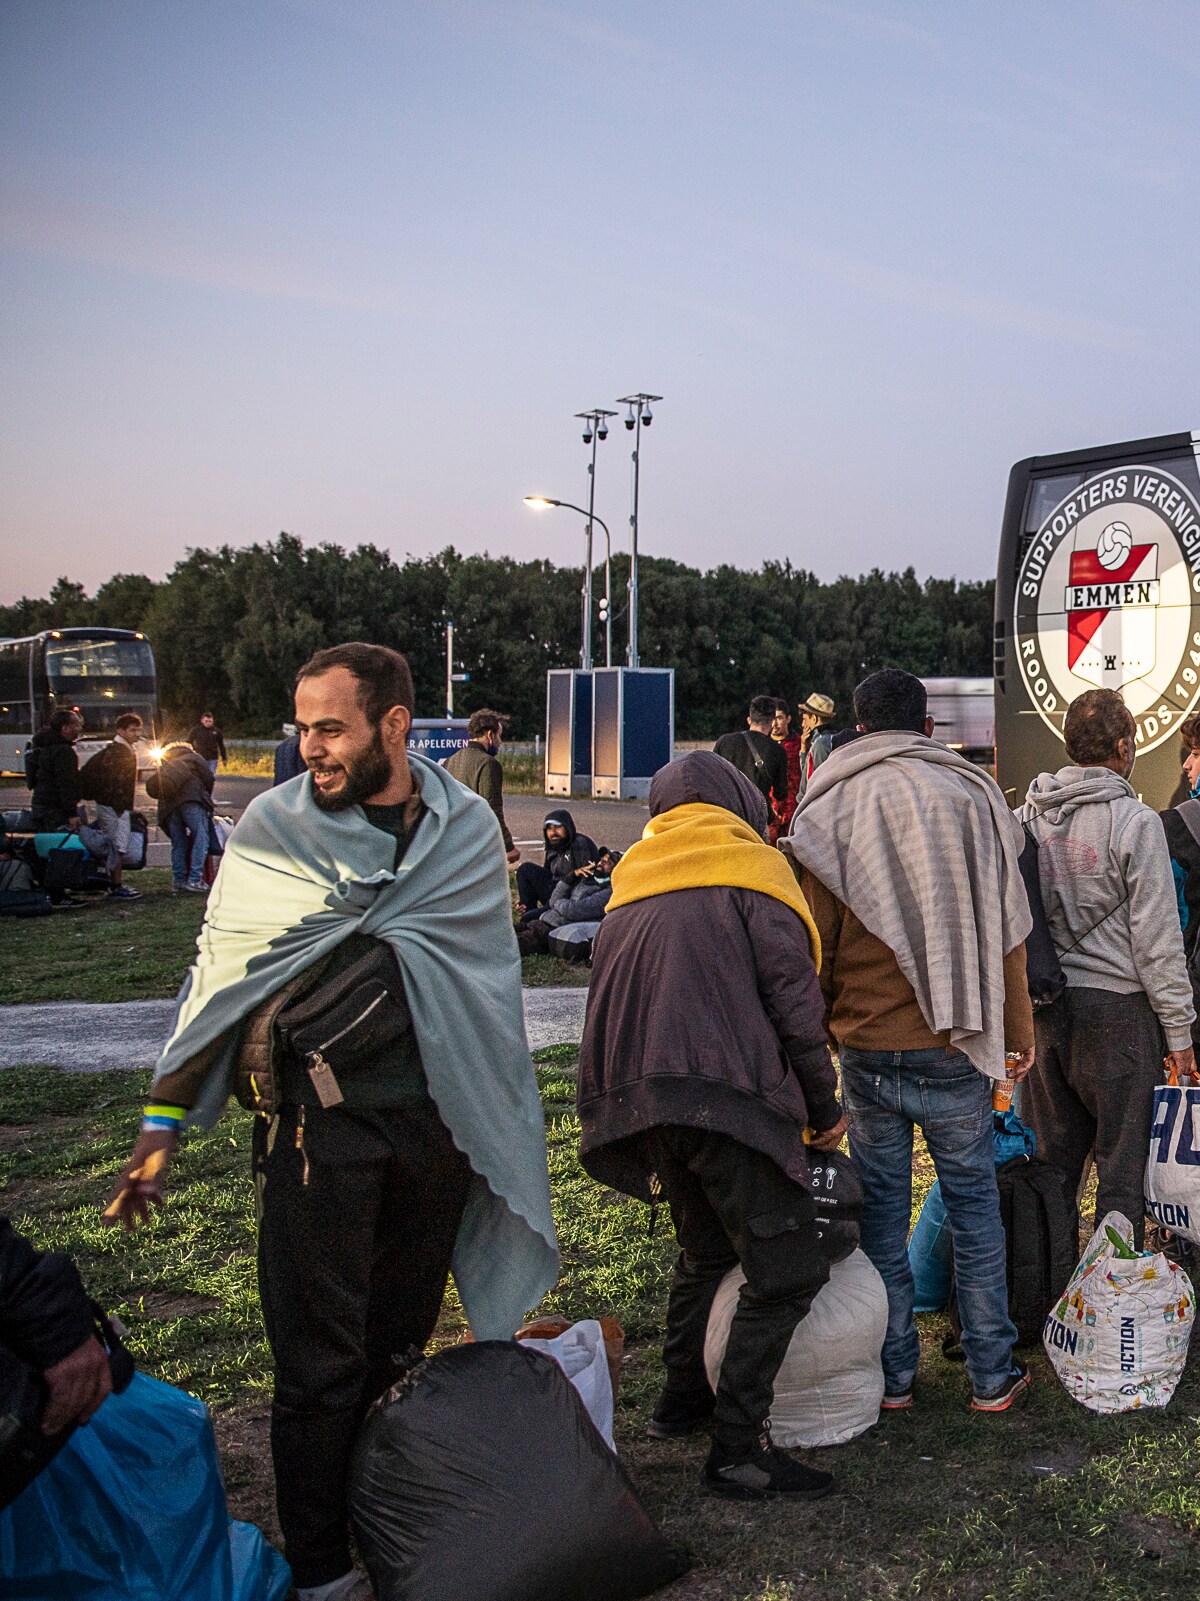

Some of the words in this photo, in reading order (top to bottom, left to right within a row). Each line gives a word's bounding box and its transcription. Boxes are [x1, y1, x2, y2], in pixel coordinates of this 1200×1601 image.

[1021, 474, 1128, 599] SUPPORTERS
[1072, 582, 1152, 608] EMMEN
[1021, 638, 1057, 713] ROOD
[417, 738, 473, 749] APELERVEN
[1147, 1200, 1190, 1229] TION
[1043, 1315, 1079, 1357] TION
[1120, 1316, 1135, 1374] ACTION
